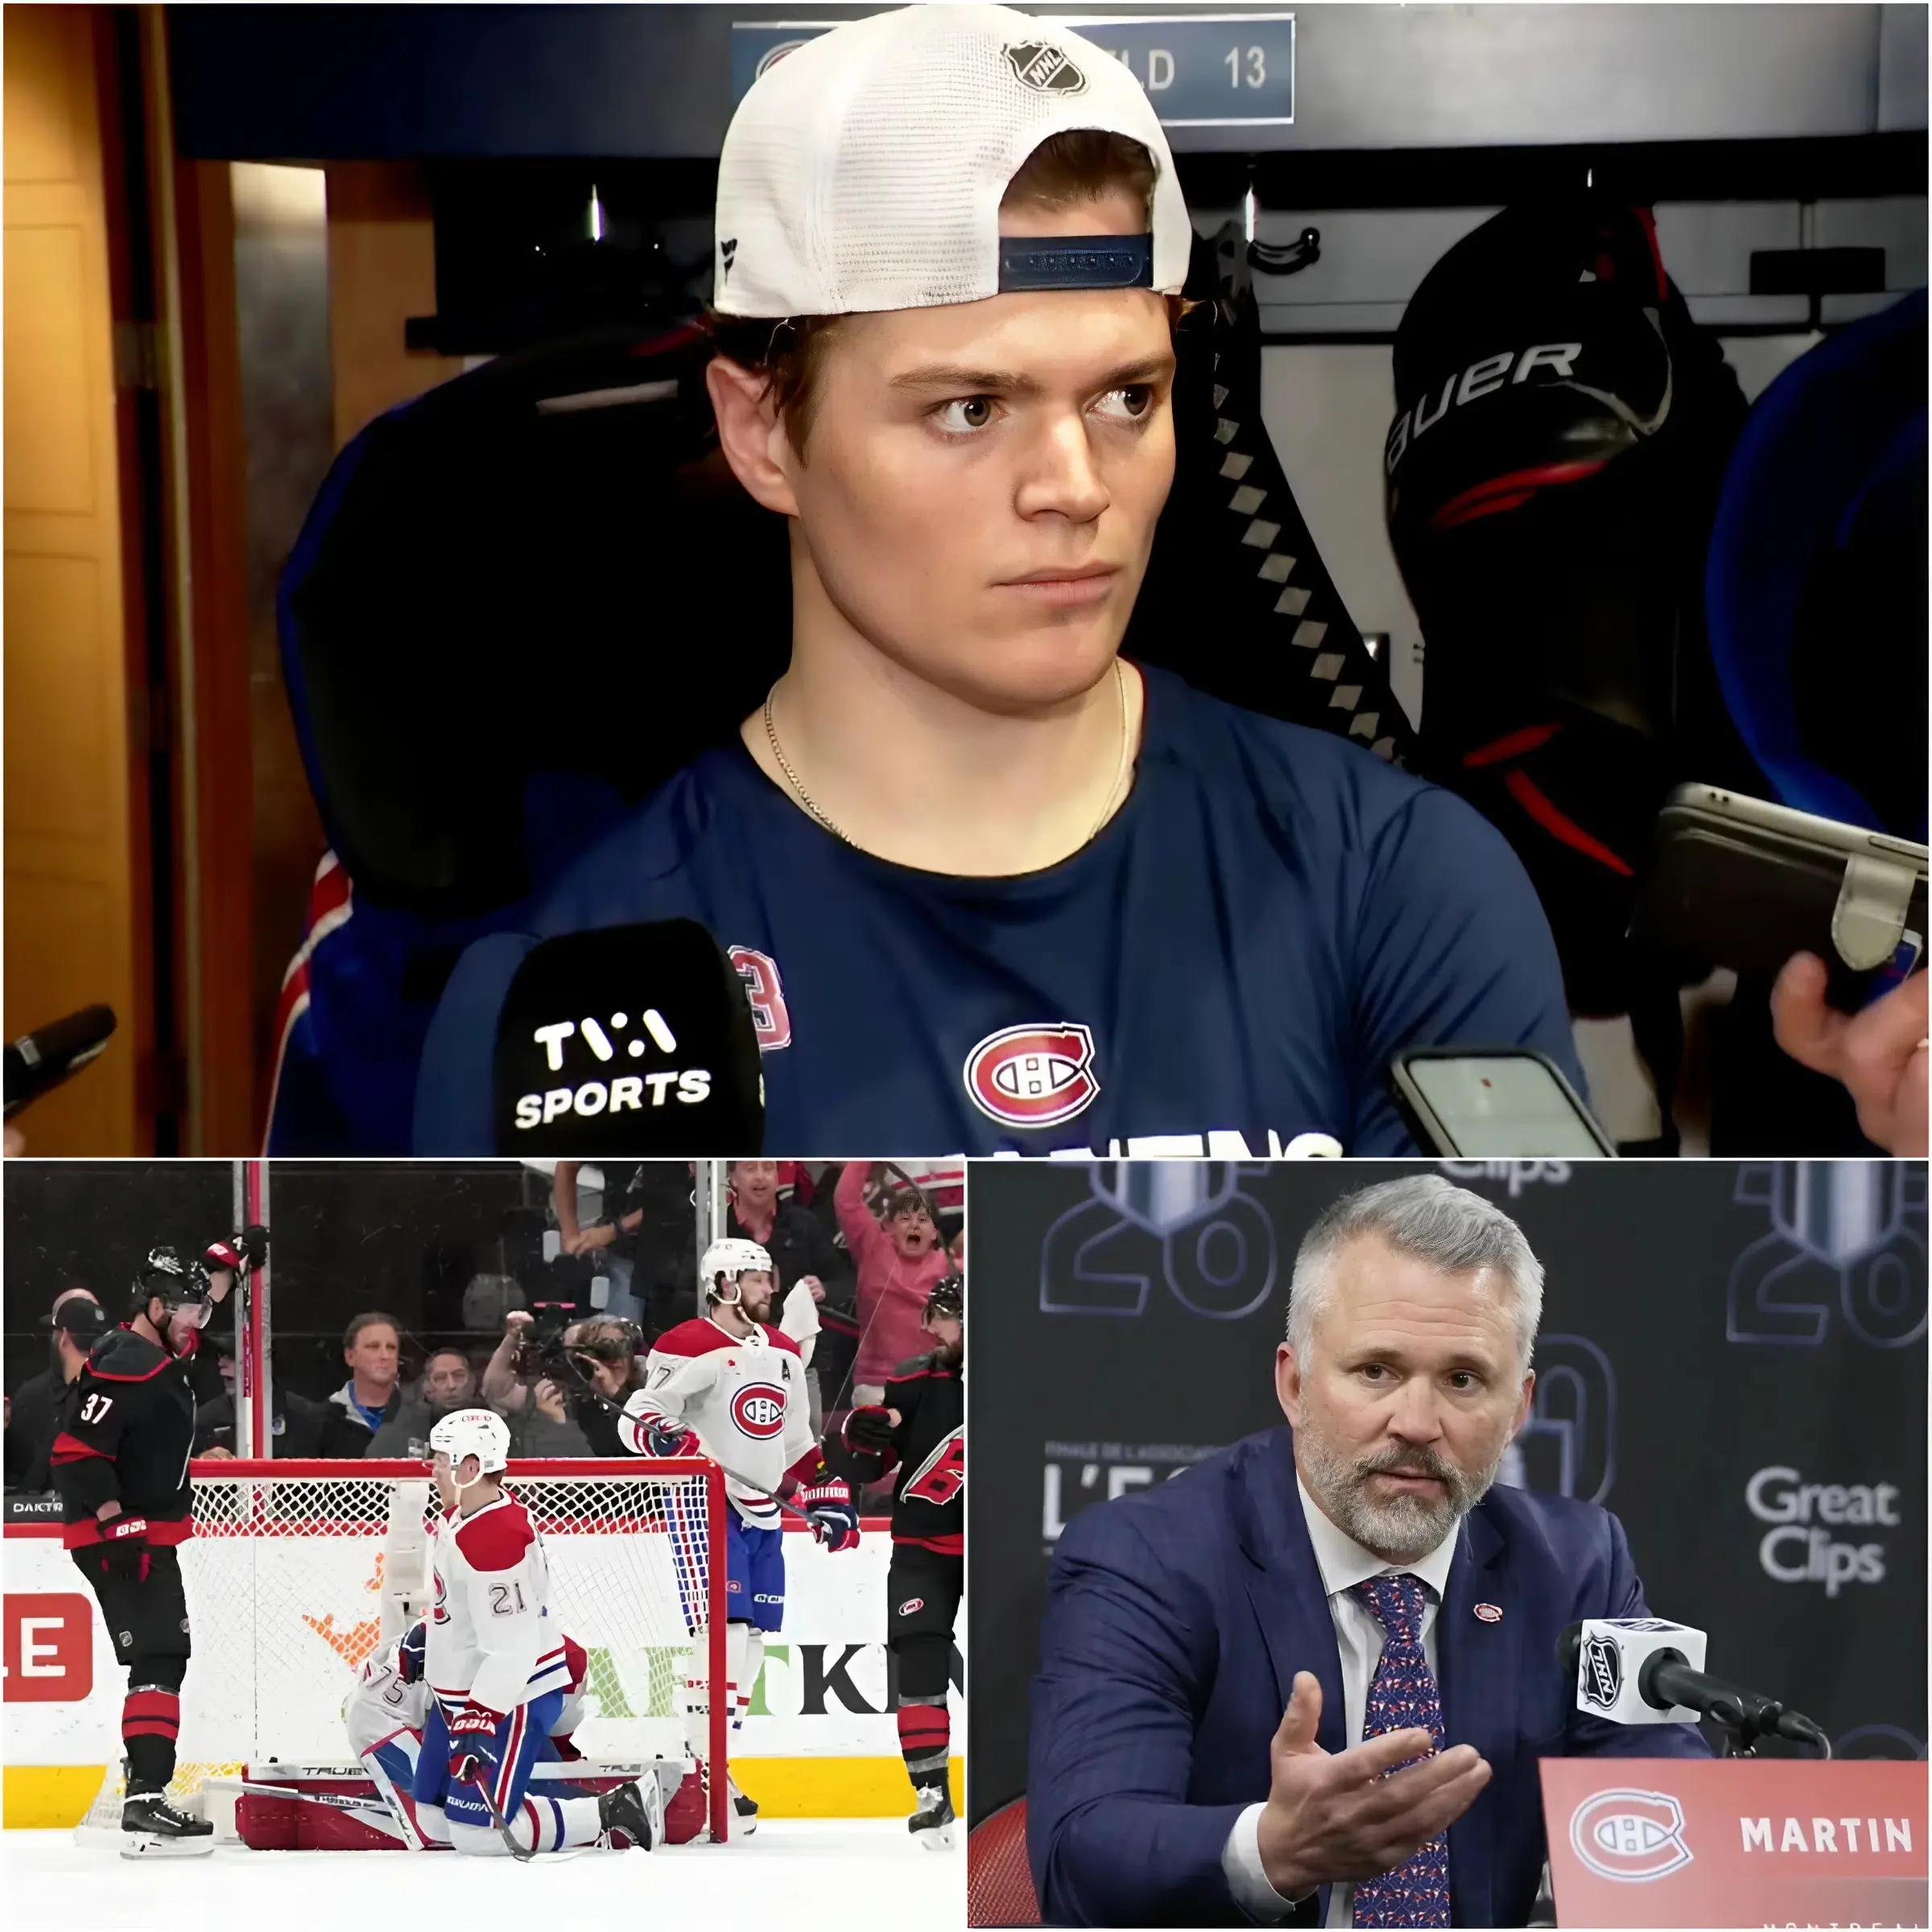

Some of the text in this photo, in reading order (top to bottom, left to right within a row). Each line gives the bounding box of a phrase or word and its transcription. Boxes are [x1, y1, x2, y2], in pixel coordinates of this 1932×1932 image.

[1030, 50, 1063, 86] NHL
[1224, 46, 1266, 89] 13
[514, 1069, 712, 1129] SPORTS
[80, 1393, 114, 1425] 37
[1745, 1465, 1901, 1526] Great
[1758, 1525, 1886, 1597] Clips
[488, 1581, 527, 1616] 21
[3, 1616, 66, 1678] E
[1740, 1817, 1913, 1852] MARTIN
